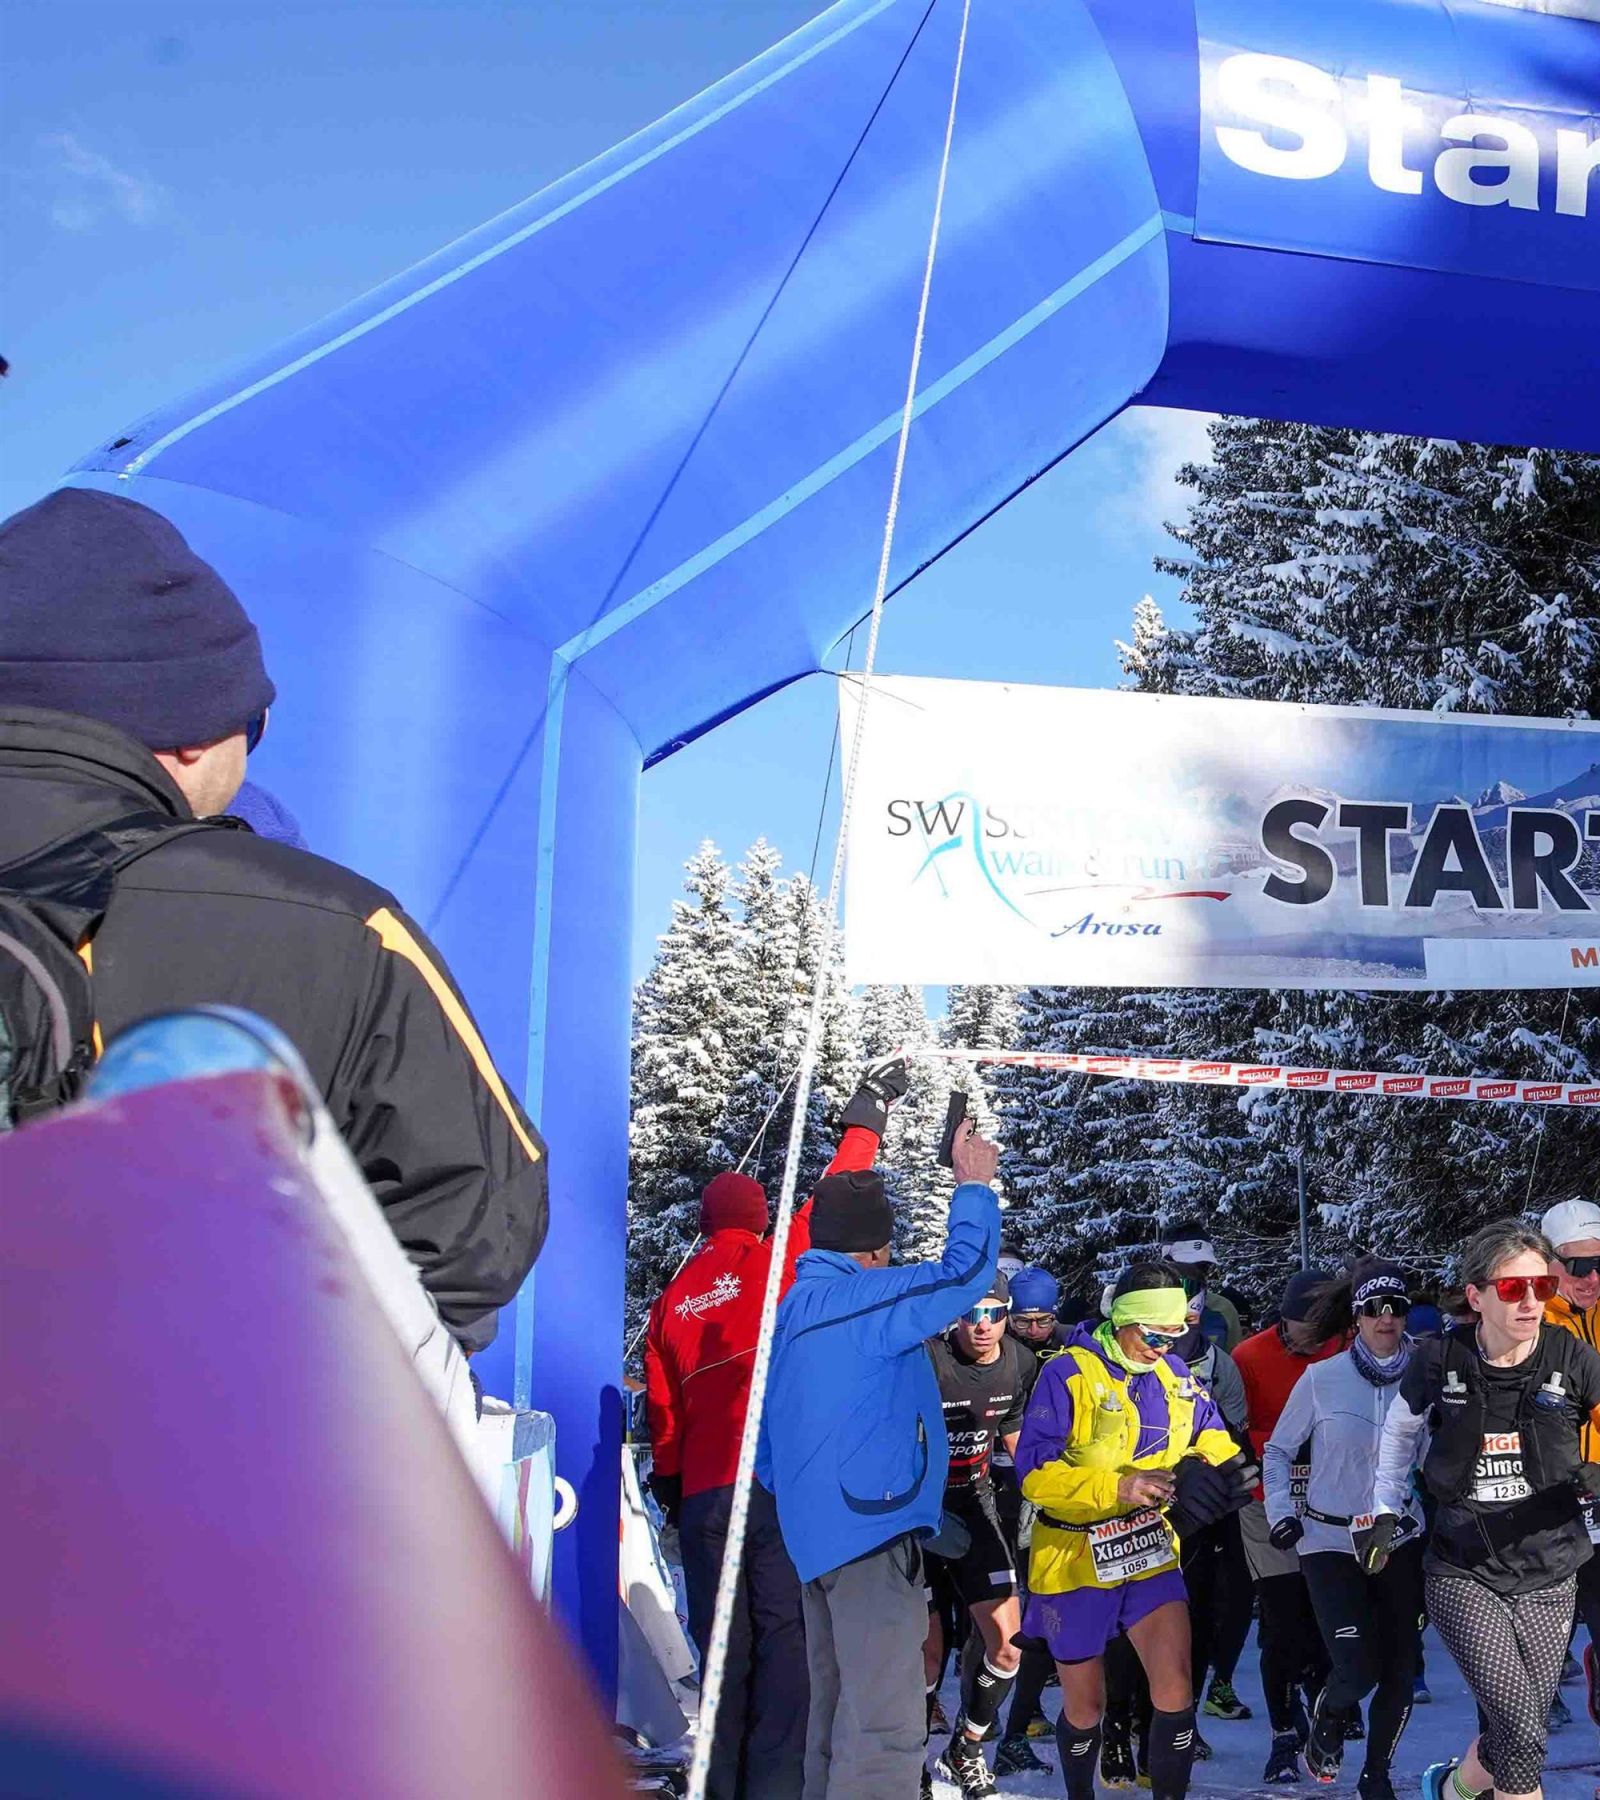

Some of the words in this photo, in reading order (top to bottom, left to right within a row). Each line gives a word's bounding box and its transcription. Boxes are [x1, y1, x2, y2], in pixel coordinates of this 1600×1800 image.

[1050, 911, 1163, 938] Arosa
[1291, 1072, 1325, 1087] rivella
[1338, 1075, 1373, 1090] rivella
[1387, 1078, 1421, 1092] rivella
[1434, 1081, 1467, 1095] rivella
[1481, 1084, 1512, 1098] rivella
[1526, 1086, 1558, 1100] rivella
[1355, 1276, 1406, 1300] TERREX
[1475, 1459, 1523, 1477] Simo
[1493, 1484, 1526, 1499] 1238
[1095, 1510, 1157, 1539] MIGROS
[1095, 1529, 1167, 1562] Xiaotong
[1122, 1559, 1148, 1576] 1059
